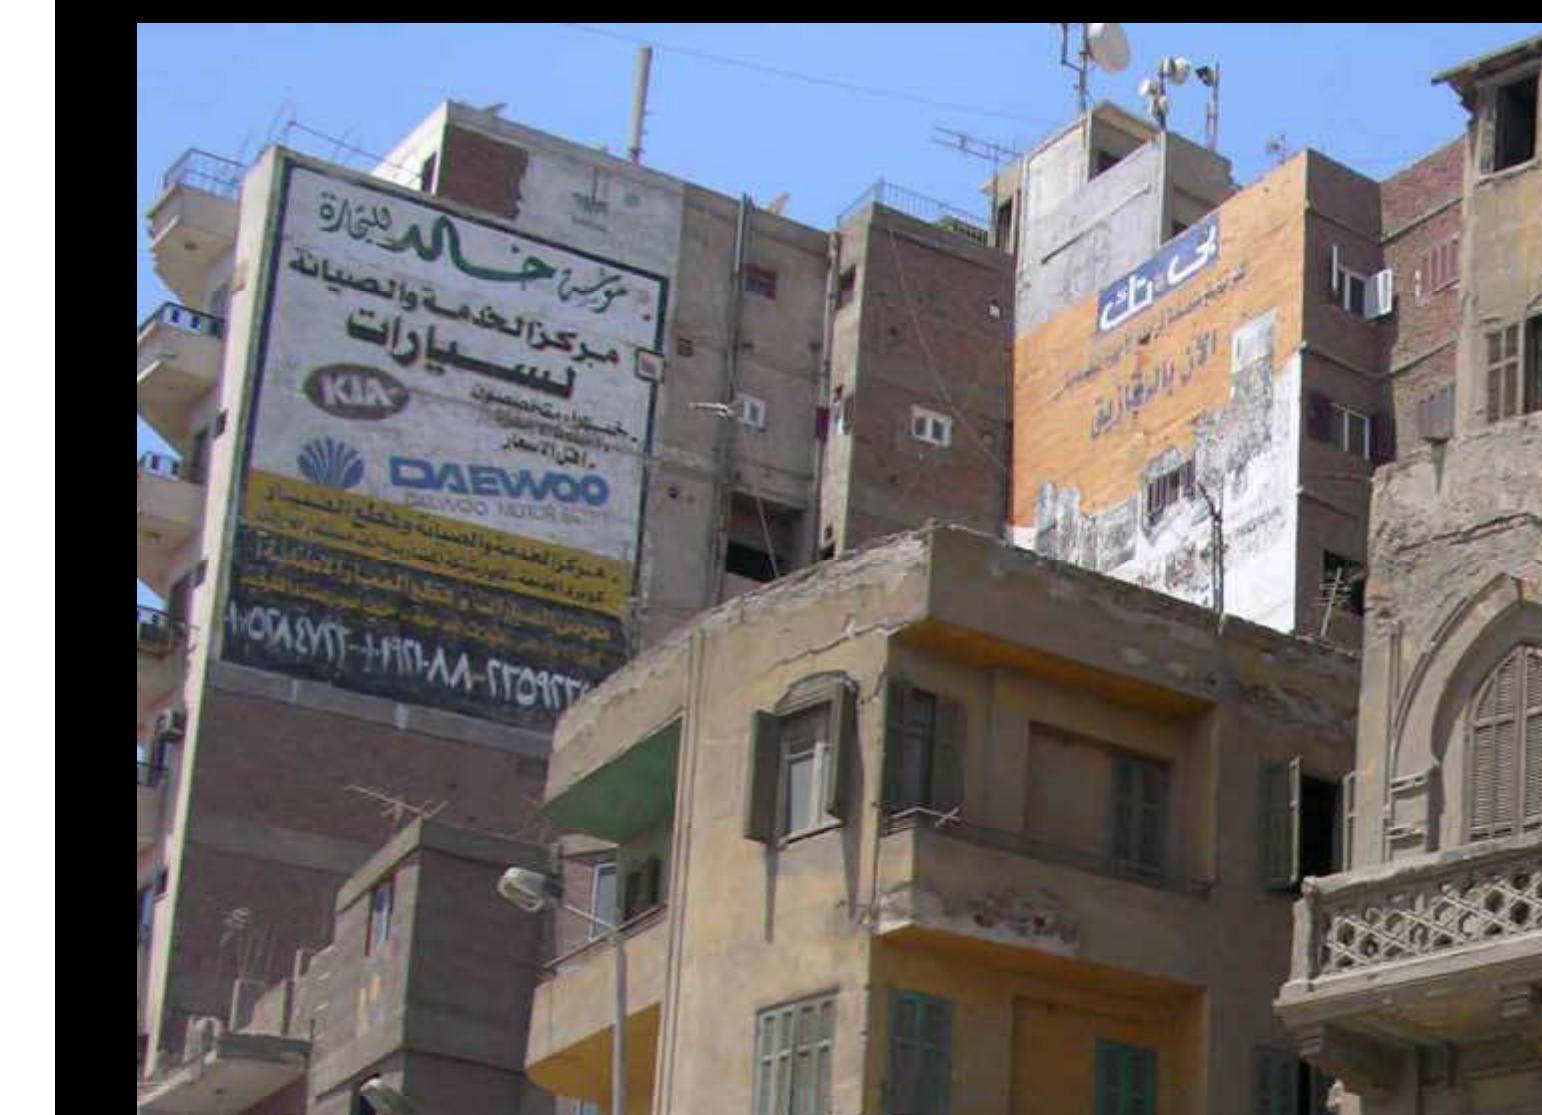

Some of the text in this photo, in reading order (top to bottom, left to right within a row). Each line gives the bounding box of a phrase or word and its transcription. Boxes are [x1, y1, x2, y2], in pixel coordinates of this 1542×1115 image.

[377, 215, 558, 281] خالد
[322, 377, 390, 407] KIA
[389, 455, 610, 507] DAEWOO
